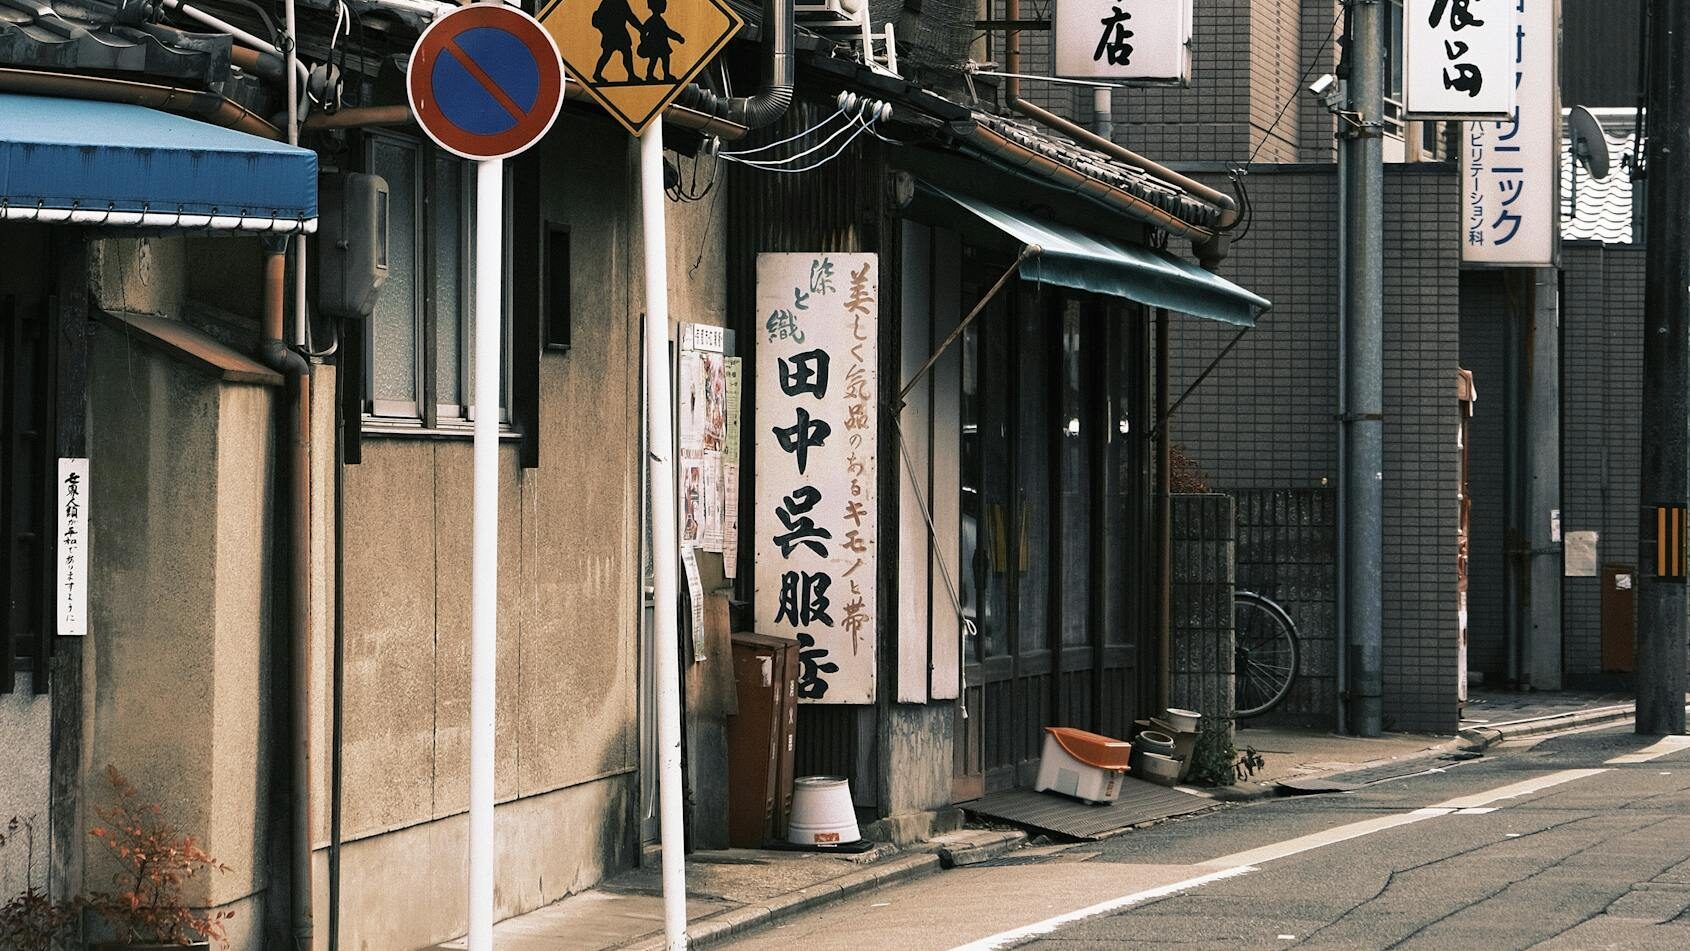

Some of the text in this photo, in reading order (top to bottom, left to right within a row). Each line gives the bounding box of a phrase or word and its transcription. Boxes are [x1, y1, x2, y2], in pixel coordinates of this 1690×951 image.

[1093, 0, 1134, 65] 店
[765, 256, 836, 345] 染と織
[63, 472, 81, 622] 世界人類が平和でありますように
[772, 348, 840, 699] 田中呉服店
